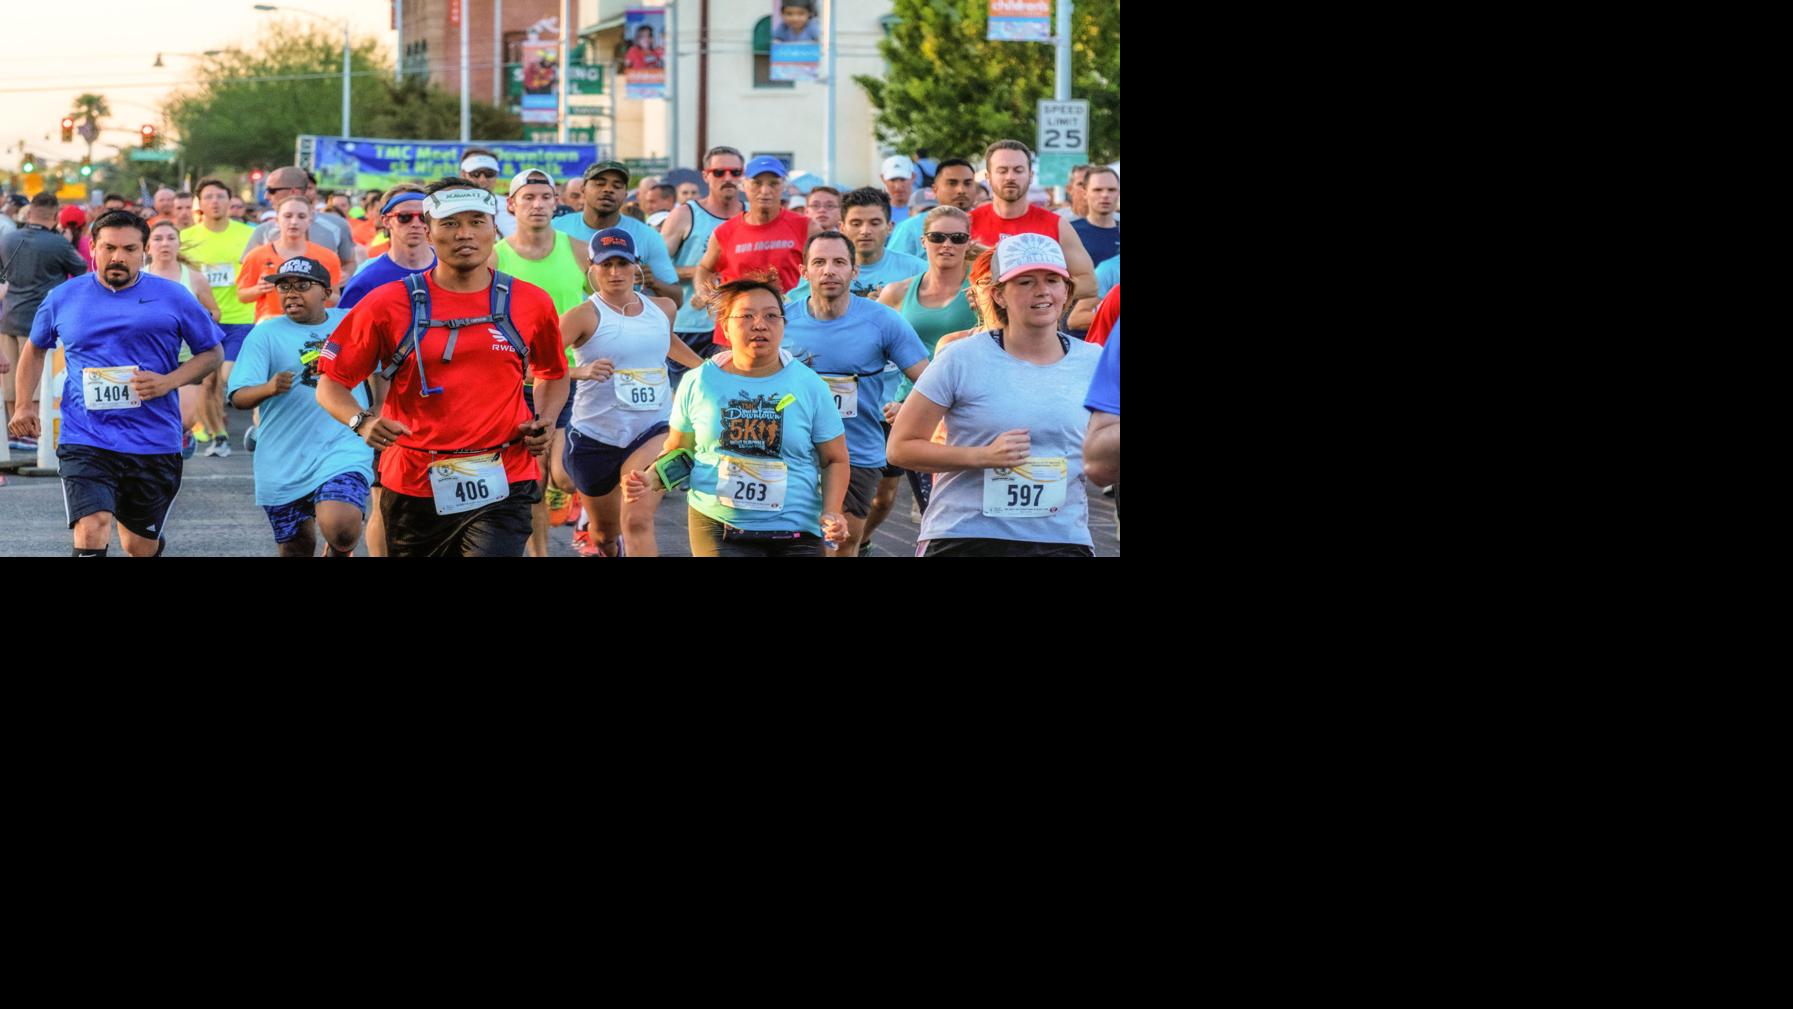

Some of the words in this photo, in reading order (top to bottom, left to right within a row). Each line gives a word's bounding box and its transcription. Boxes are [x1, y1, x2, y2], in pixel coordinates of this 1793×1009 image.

[1044, 105, 1084, 114] SPEED
[1047, 118, 1077, 126] LIMIT
[1044, 130, 1082, 148] 25
[375, 145, 412, 159] TMC
[94, 385, 129, 402] 1404
[631, 386, 656, 404] 663
[730, 418, 759, 440] 5K
[456, 478, 490, 502] 406
[734, 480, 768, 502] 263
[1007, 484, 1044, 507] 597
